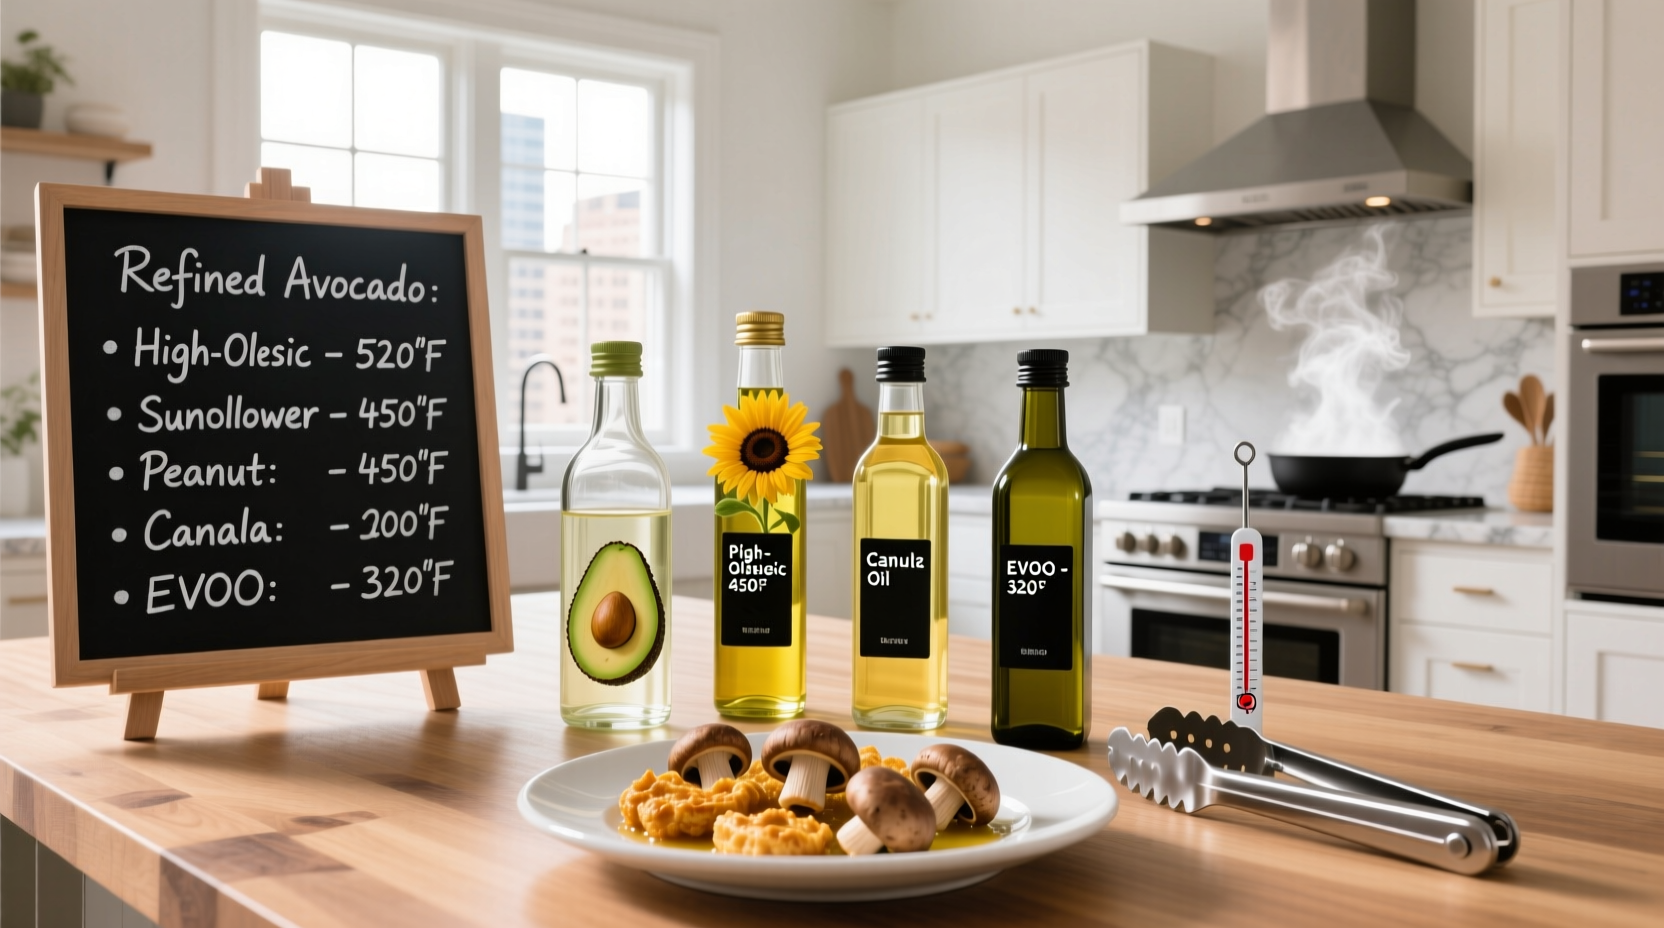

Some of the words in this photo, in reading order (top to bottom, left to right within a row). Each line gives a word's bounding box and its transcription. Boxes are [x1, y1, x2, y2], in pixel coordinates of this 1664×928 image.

[113, 244, 266, 309] Refined
[283, 255, 439, 303] Avocado:
[133, 326, 312, 384] High-Olesic
[137, 394, 320, 433] Sunollower
[139, 449, 277, 492] Peanut:
[144, 506, 283, 551] Canala:
[867, 570, 890, 587] Oil
[1006, 560, 1056, 576] EVOO
[146, 568, 277, 615] EVOO:
